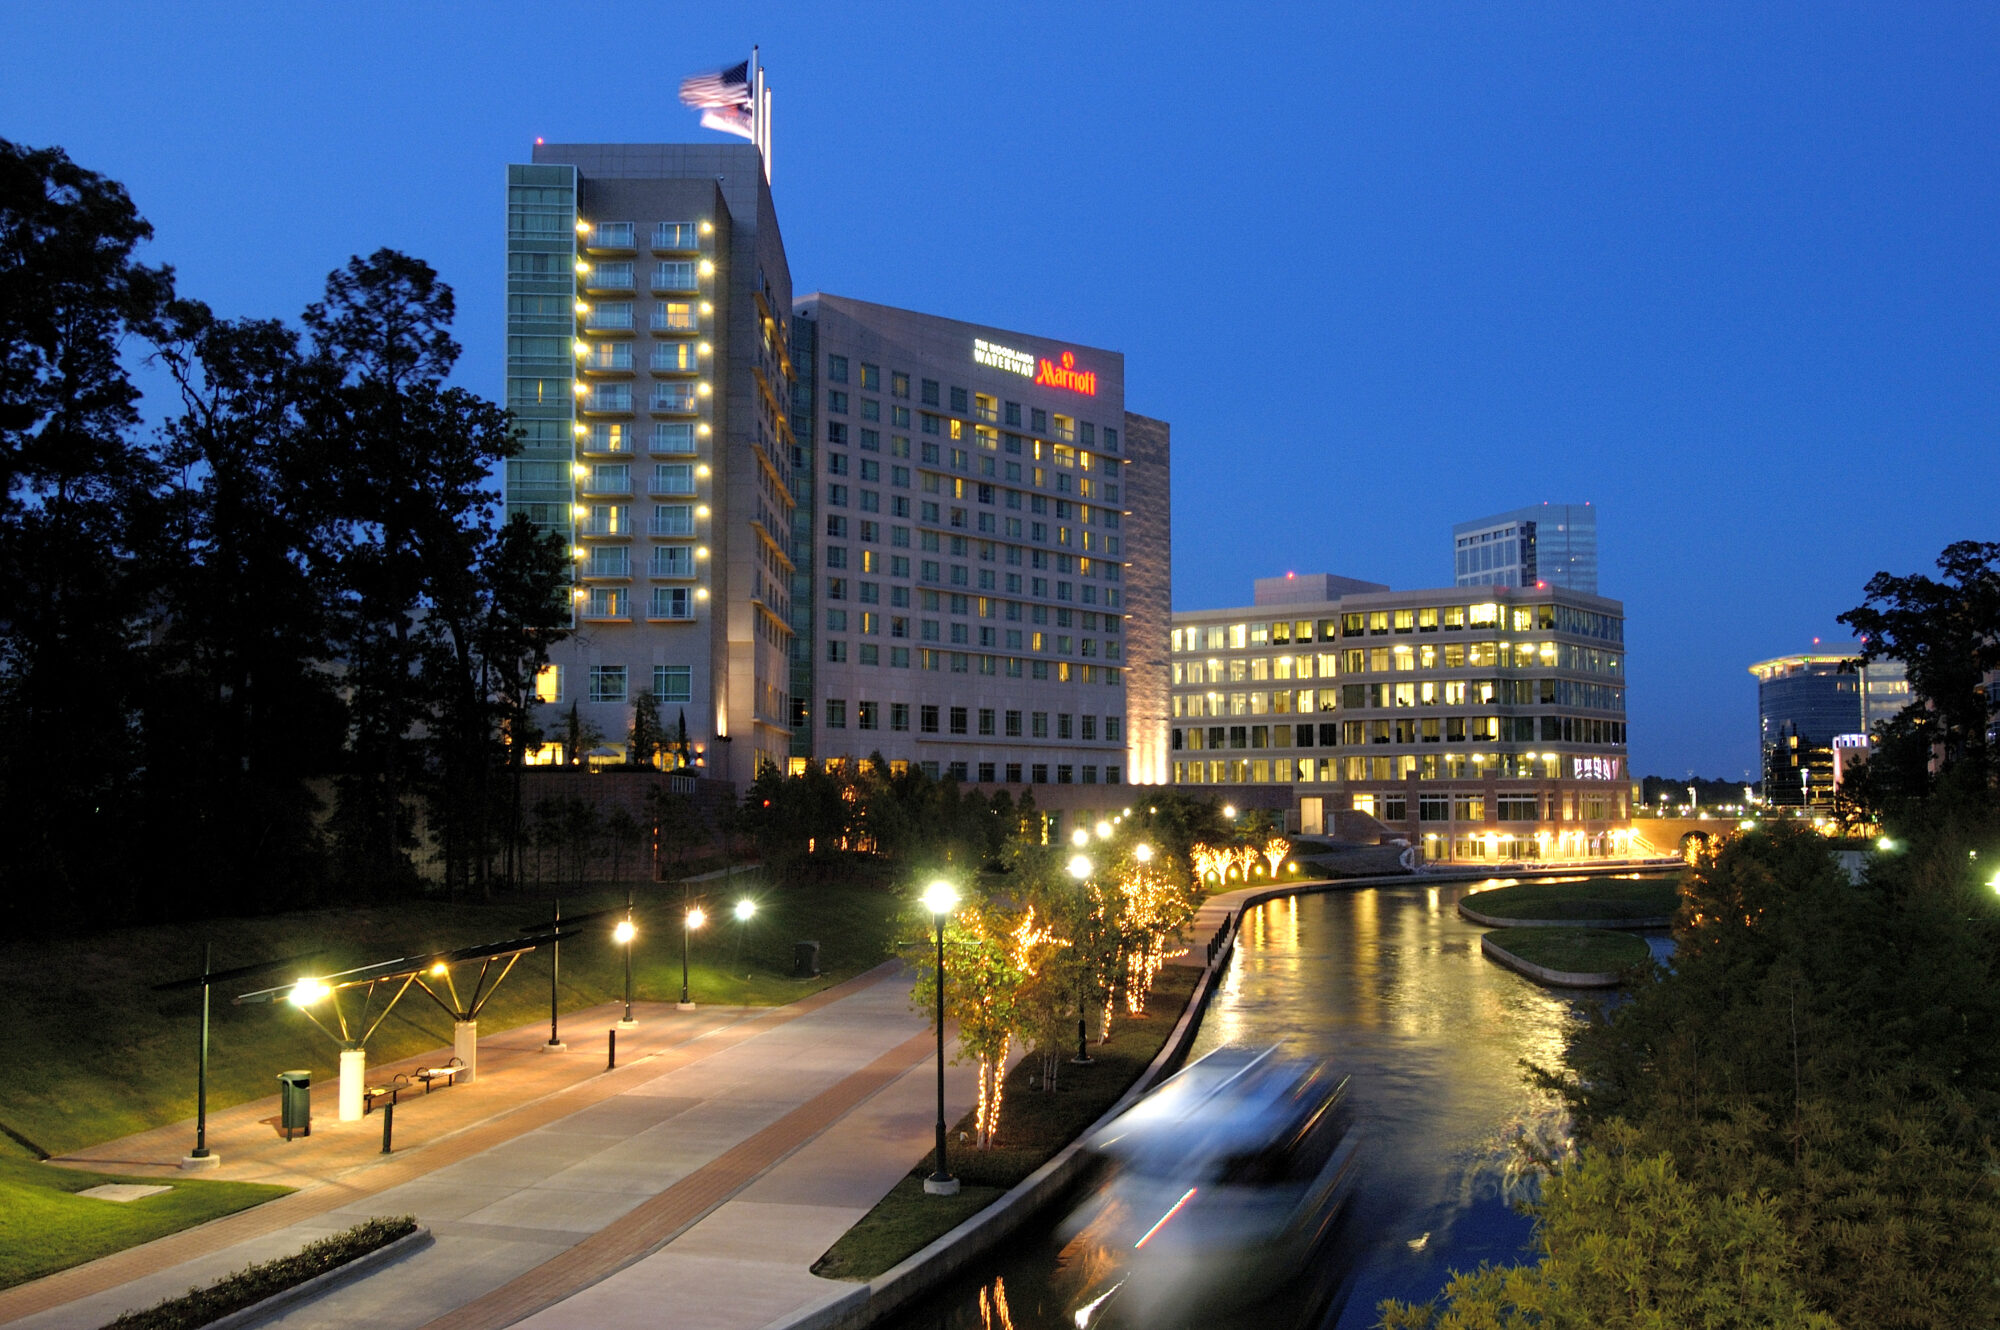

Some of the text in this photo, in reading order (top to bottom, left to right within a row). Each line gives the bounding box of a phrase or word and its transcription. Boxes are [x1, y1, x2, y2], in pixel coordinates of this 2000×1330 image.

[974, 349, 1034, 377] WATERWAY
[989, 343, 1034, 364] WOODLANDS
[1036, 352, 1096, 396] Marriott
